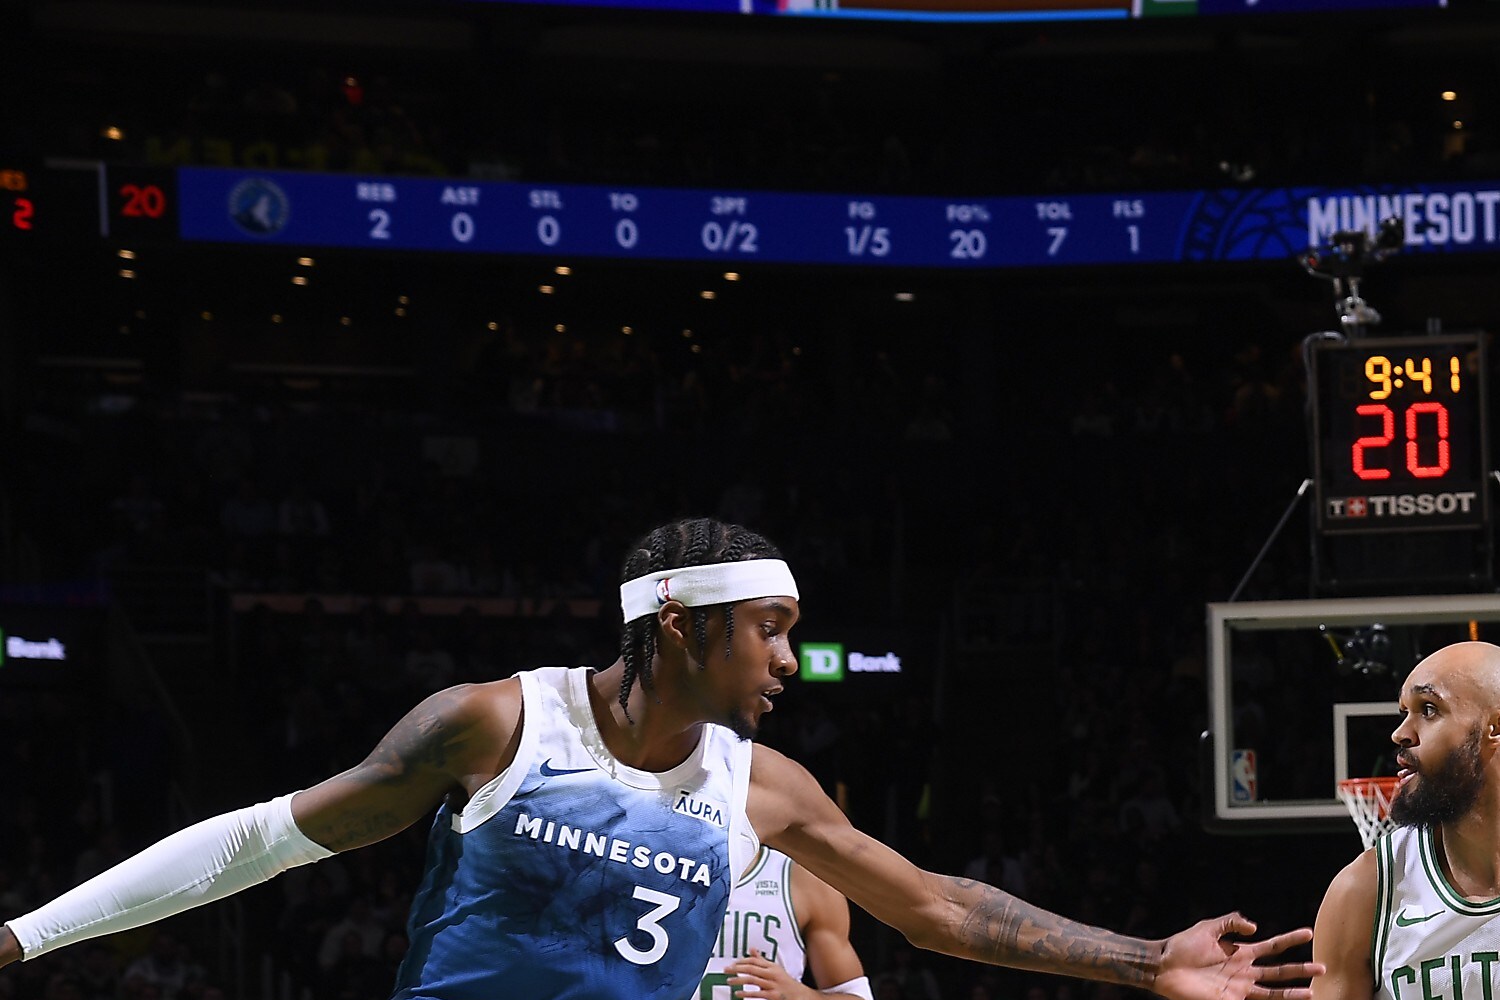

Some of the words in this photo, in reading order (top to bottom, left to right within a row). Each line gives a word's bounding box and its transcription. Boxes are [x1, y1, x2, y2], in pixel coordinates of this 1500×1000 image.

[12, 197, 35, 231] 2
[119, 183, 166, 219] 20
[440, 186, 480, 206] AST
[368, 207, 391, 240] 2
[450, 211, 475, 244] 0
[536, 214, 561, 247] 0
[614, 217, 639, 250] 0
[700, 220, 759, 254] 0/2
[844, 224, 891, 258] 1/5
[948, 228, 988, 260] 20
[1046, 226, 1068, 256] 7
[1126, 224, 1140, 254] 1
[1364, 355, 1461, 400] 9:41
[1351, 402, 1449, 480] 20
[1368, 491, 1477, 517] TISSOT
[803, 648, 841, 675] TD
[847, 651, 902, 673] Bank
[513, 813, 712, 887] MINNESOTA
[613, 884, 682, 966] 3
[711, 910, 782, 963] TICS
